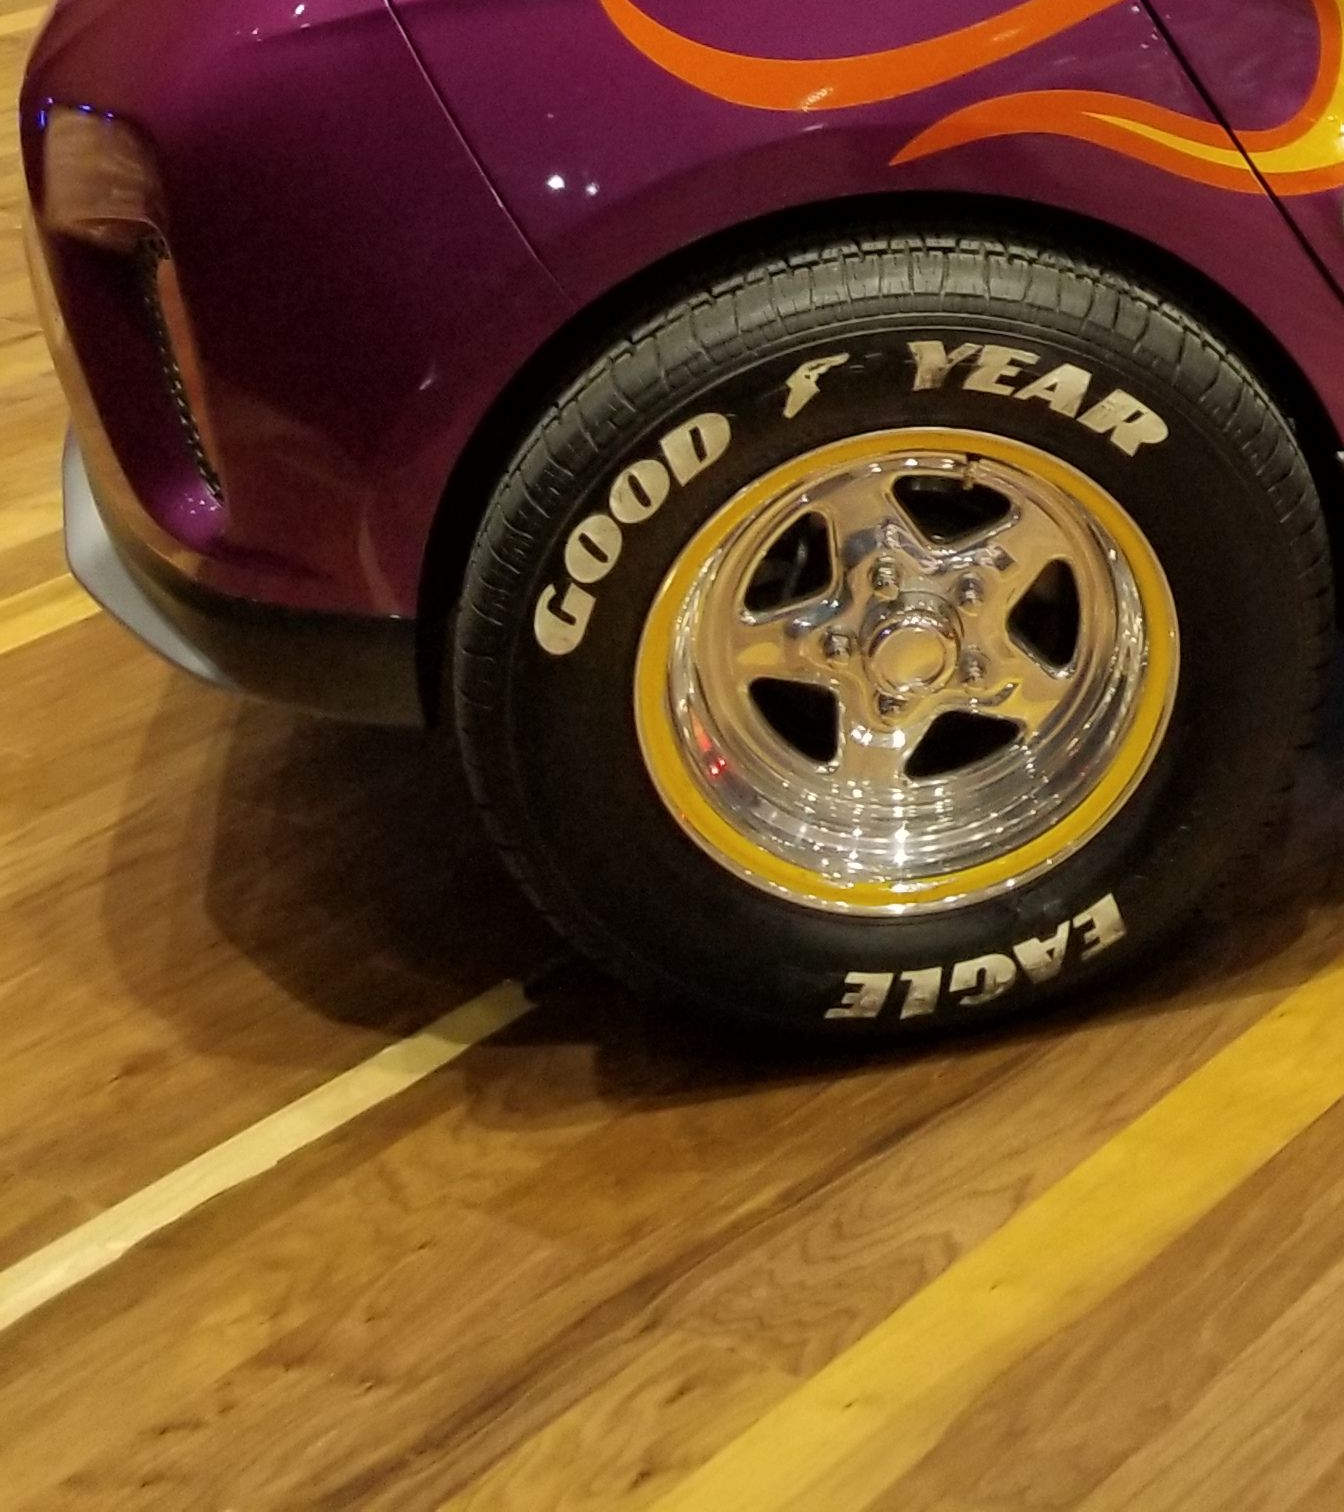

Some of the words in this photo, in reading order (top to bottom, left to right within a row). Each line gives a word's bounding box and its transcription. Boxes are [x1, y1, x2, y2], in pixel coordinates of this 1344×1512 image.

[533, 412, 731, 656] GOOD
[906, 339, 1169, 458] YEAR
[825, 893, 1129, 1020] EAGLE
